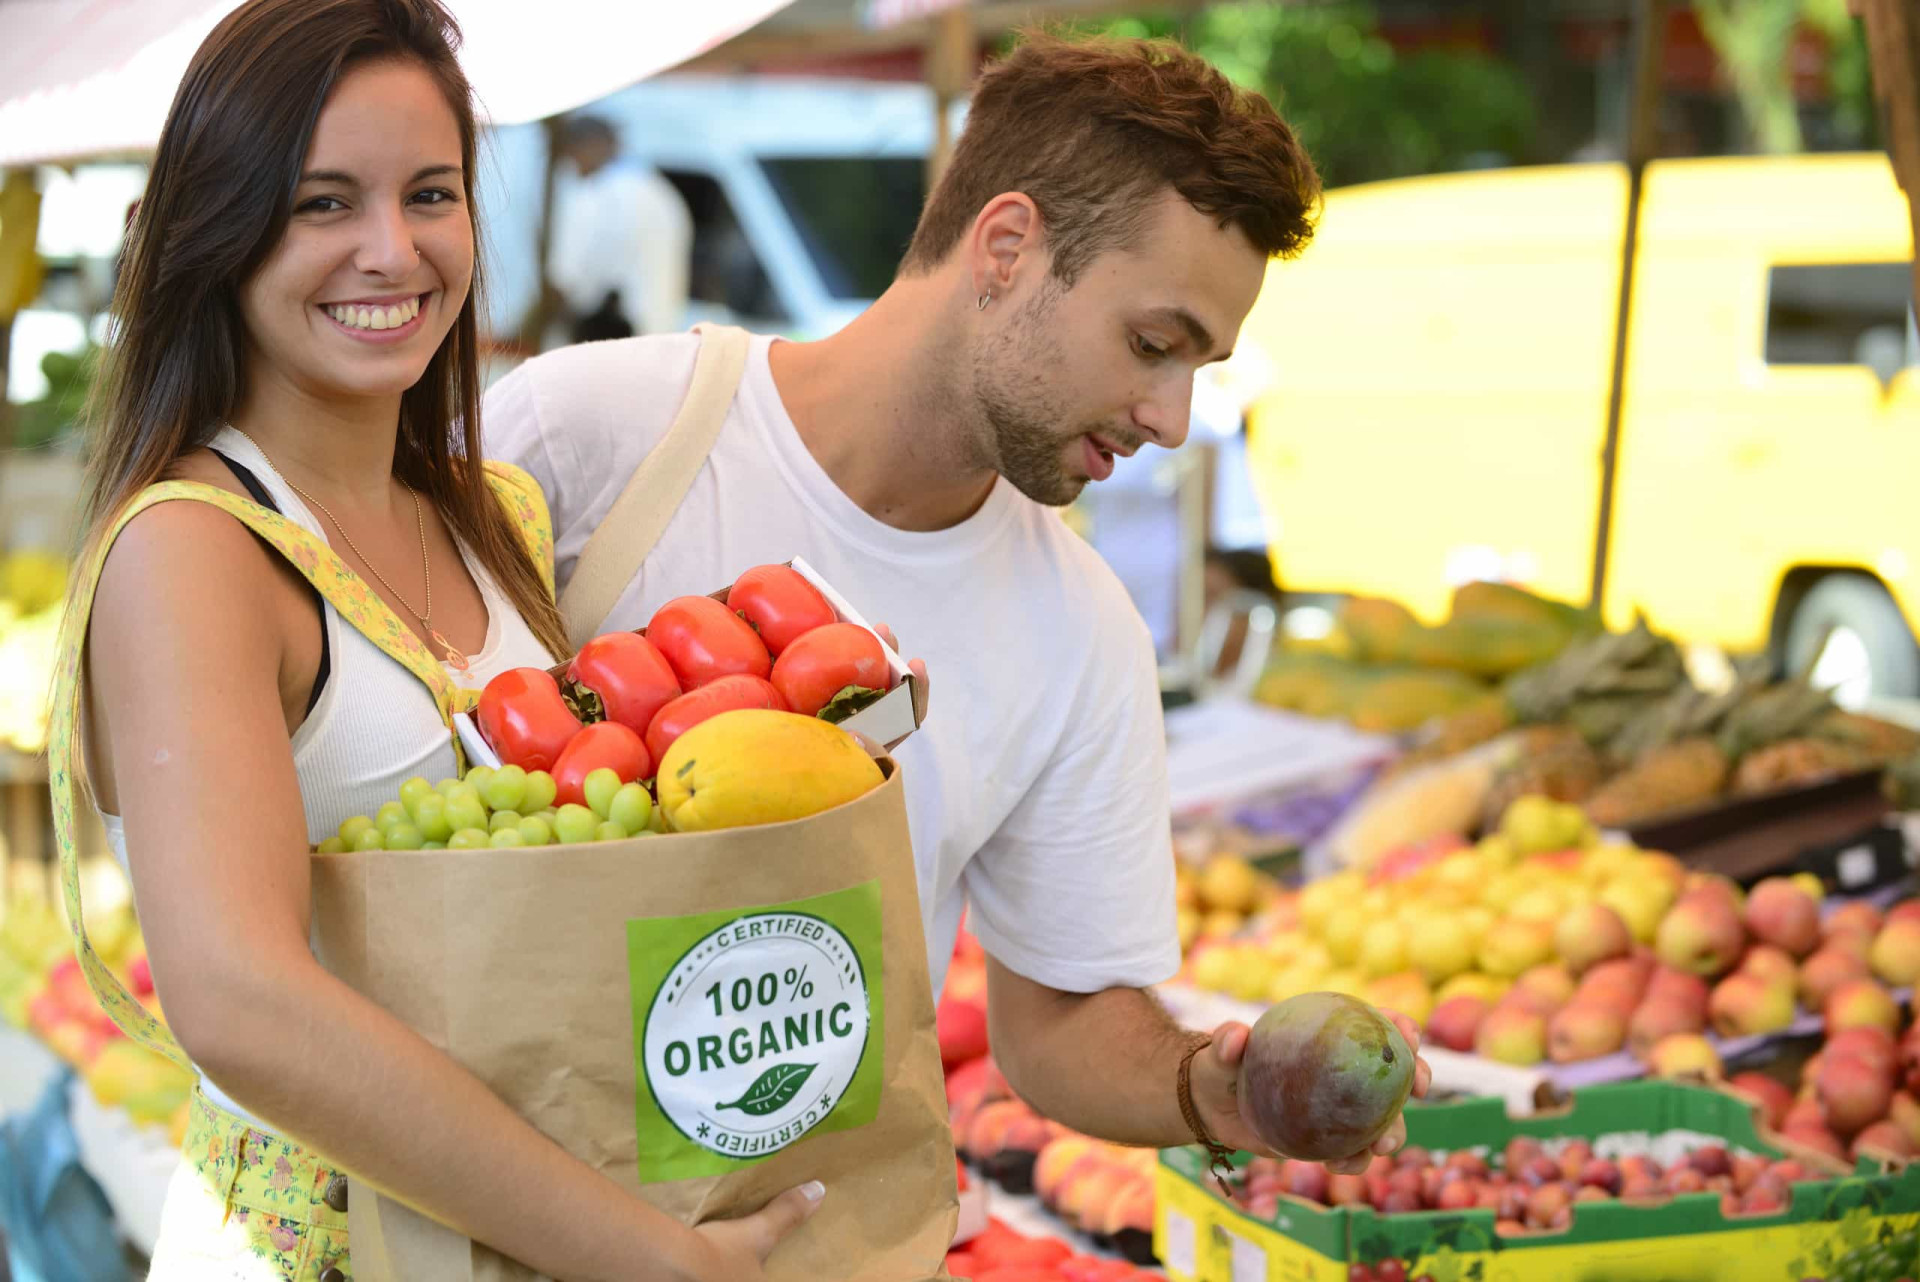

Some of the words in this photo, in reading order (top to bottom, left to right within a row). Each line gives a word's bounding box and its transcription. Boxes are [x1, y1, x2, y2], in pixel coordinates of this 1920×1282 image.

[717, 918, 825, 948] CERTIFIED
[706, 964, 814, 1017] 100%
[664, 1002, 853, 1077] ORGANIC
[715, 1110, 818, 1153] CERTIFIED
